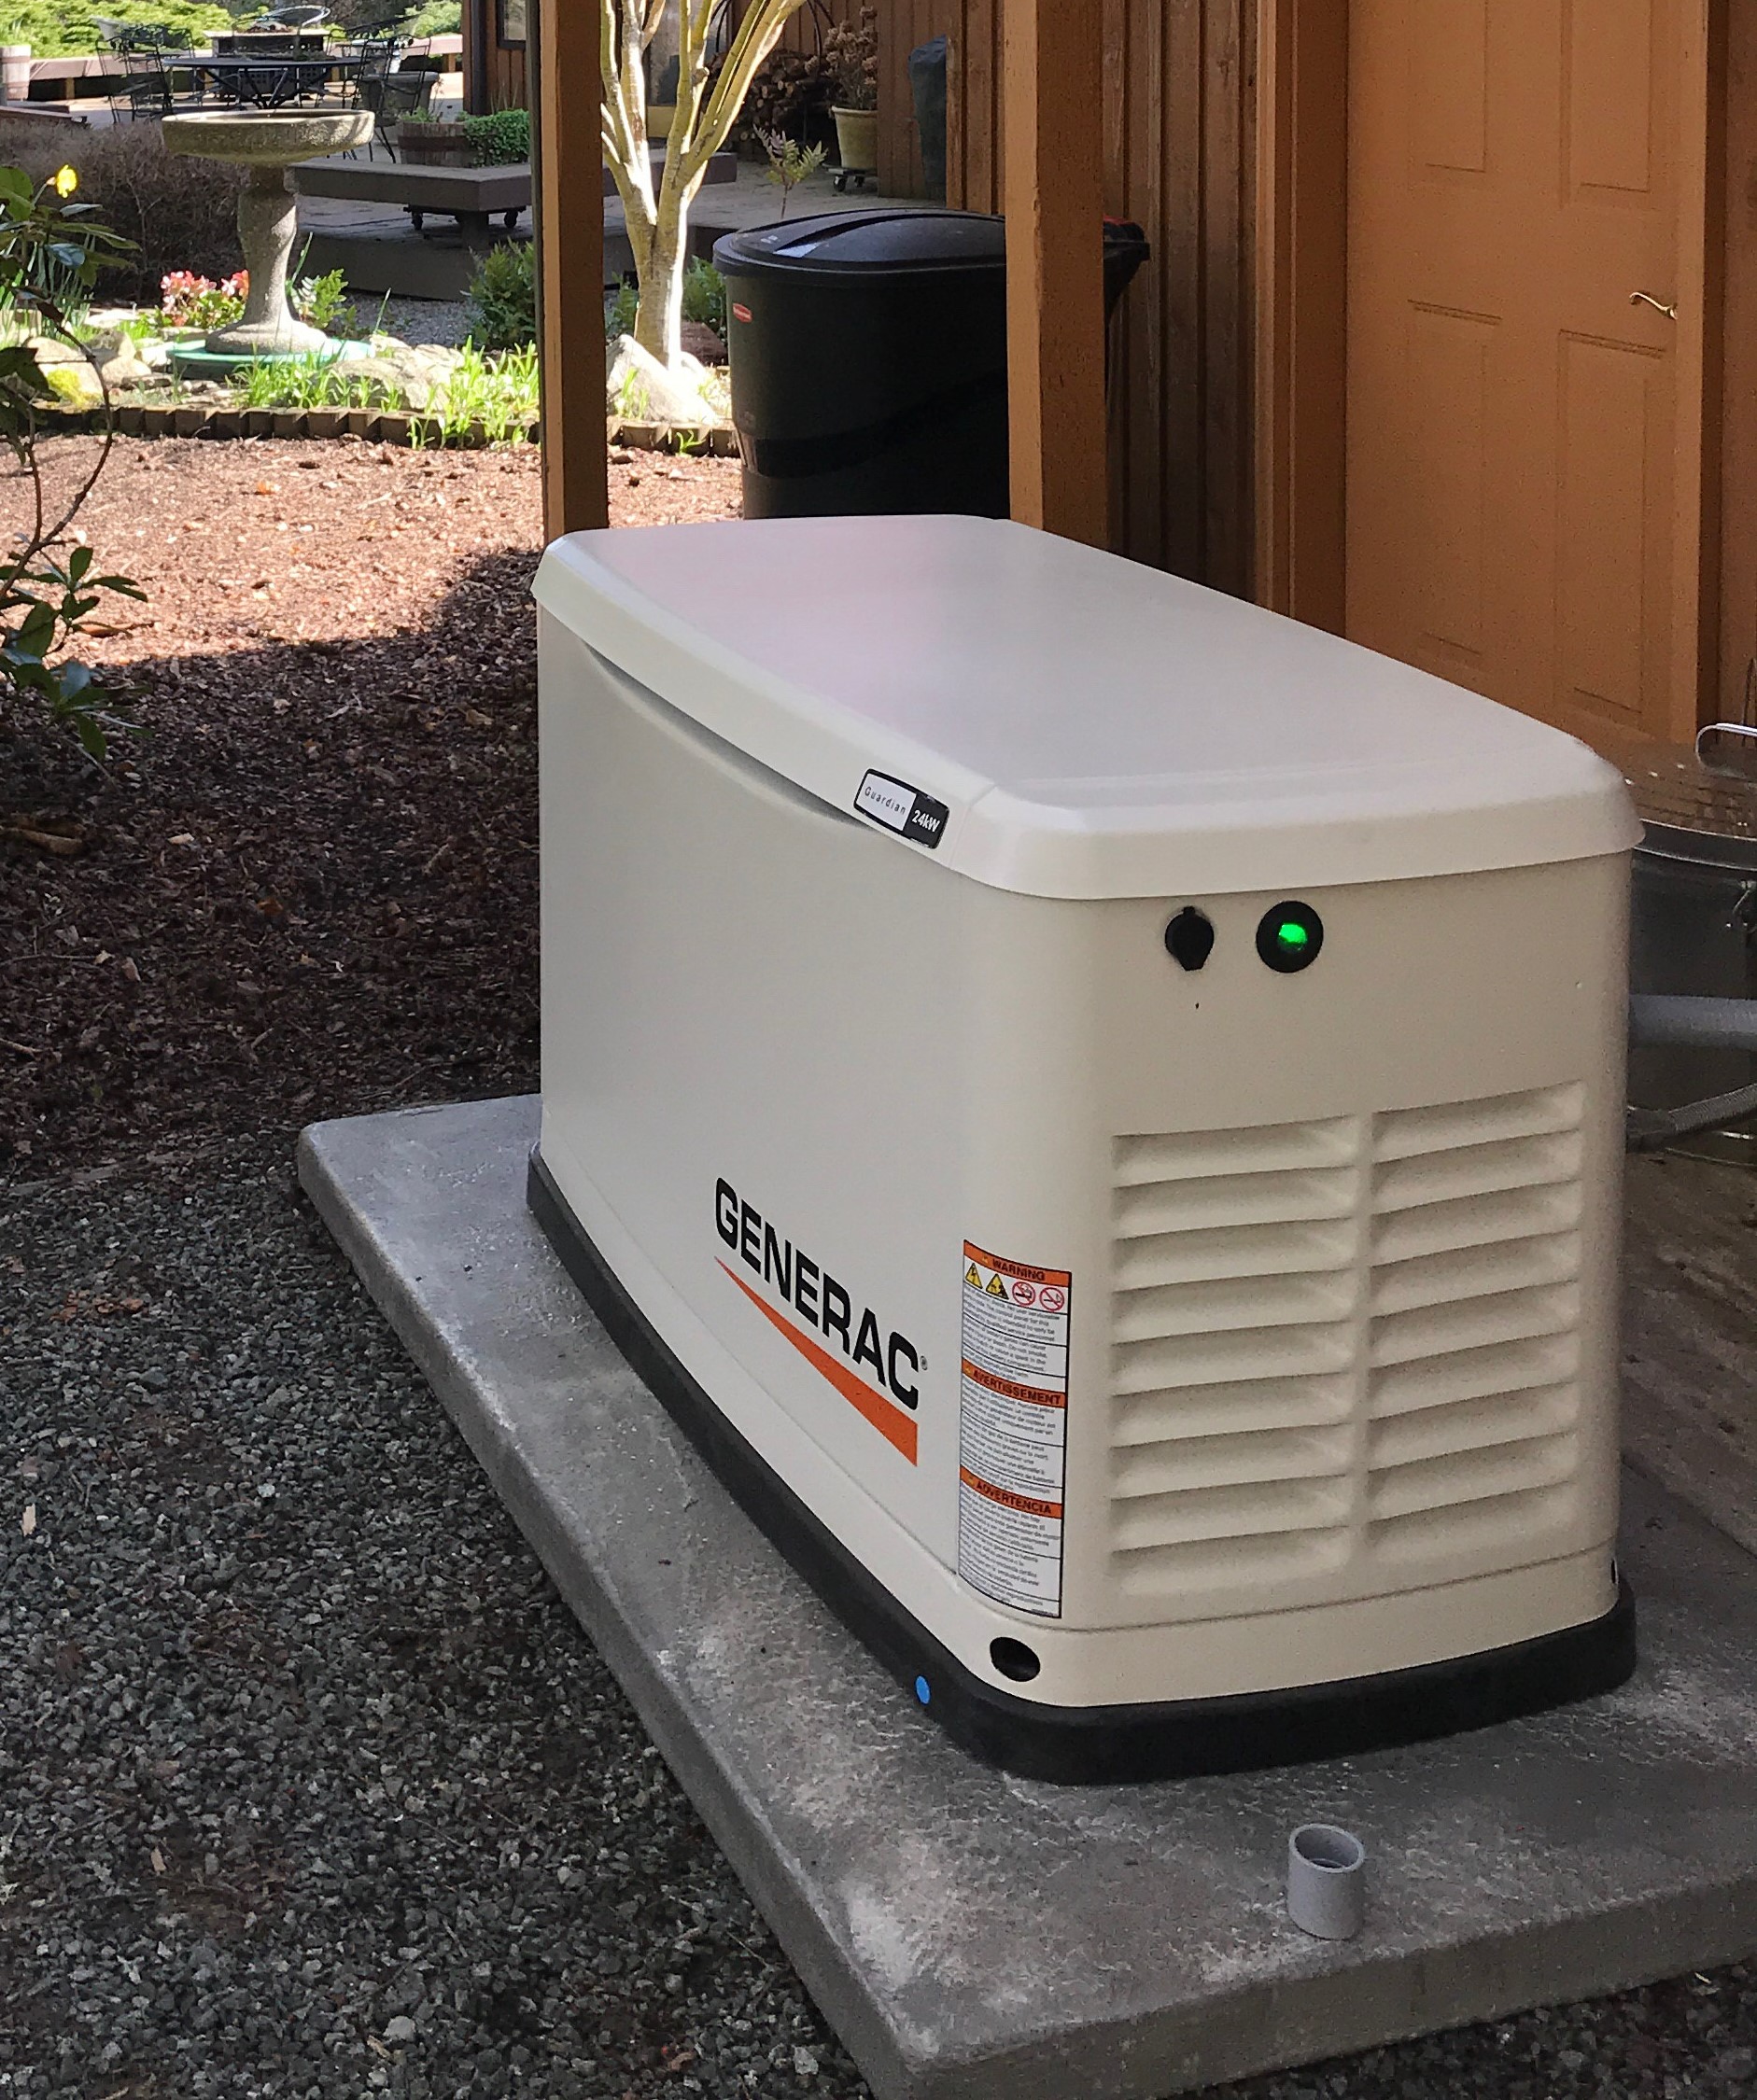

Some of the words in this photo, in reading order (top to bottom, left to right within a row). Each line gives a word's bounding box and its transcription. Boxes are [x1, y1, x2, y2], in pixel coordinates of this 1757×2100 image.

[864, 786, 907, 815] Guardian
[912, 809, 941, 833] 24kW
[992, 1258, 1045, 1281] WARNING
[715, 1177, 919, 1410] GENERAC
[973, 1369, 1061, 1405] AVERTISSEMENT
[977, 1481, 1052, 1514] ADVERTENCIA
